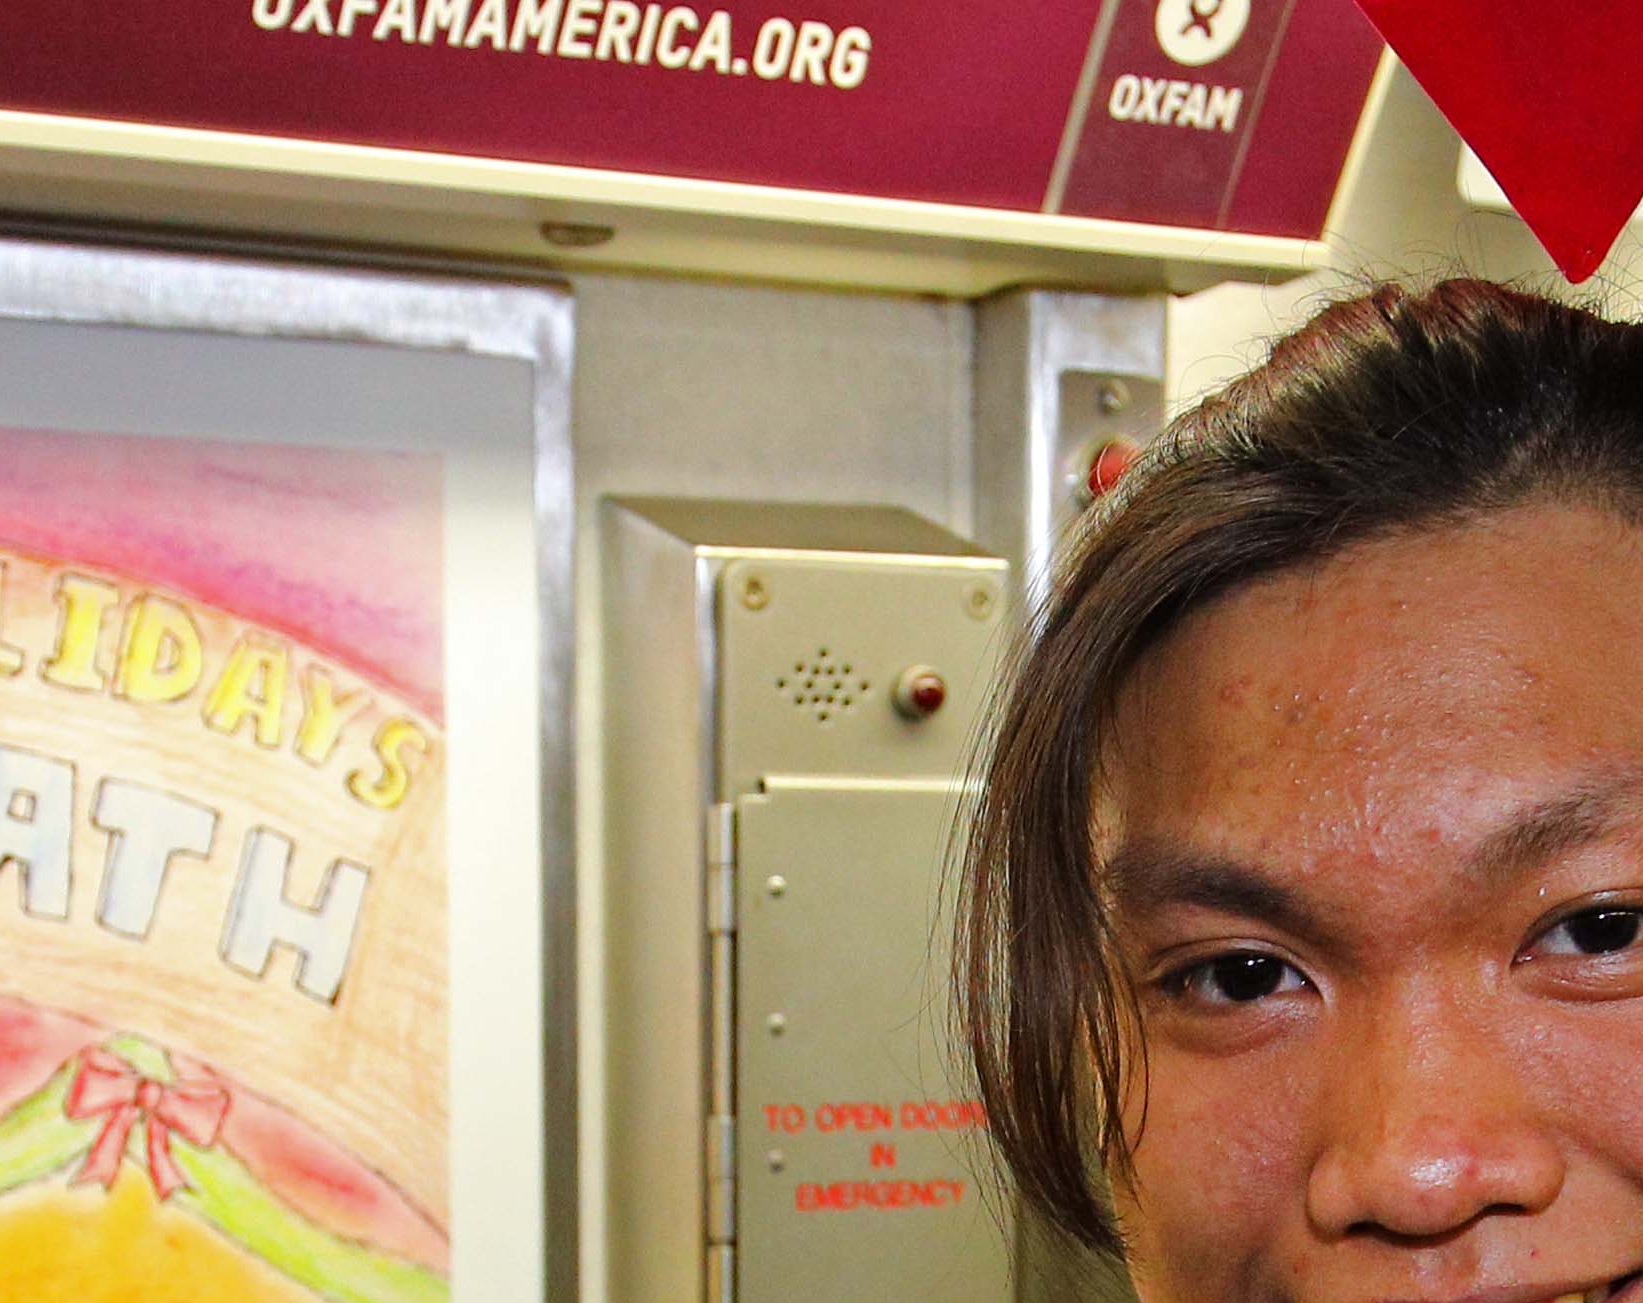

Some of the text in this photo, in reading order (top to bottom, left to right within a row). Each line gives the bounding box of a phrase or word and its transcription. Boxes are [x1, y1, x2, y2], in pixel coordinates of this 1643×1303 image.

[1108, 73, 1244, 133] OXFAM
[762, 1099, 989, 1134] TO OPEN DOOR
[869, 1141, 897, 1169] IN
[794, 1178, 966, 1212] EMERGENCY
